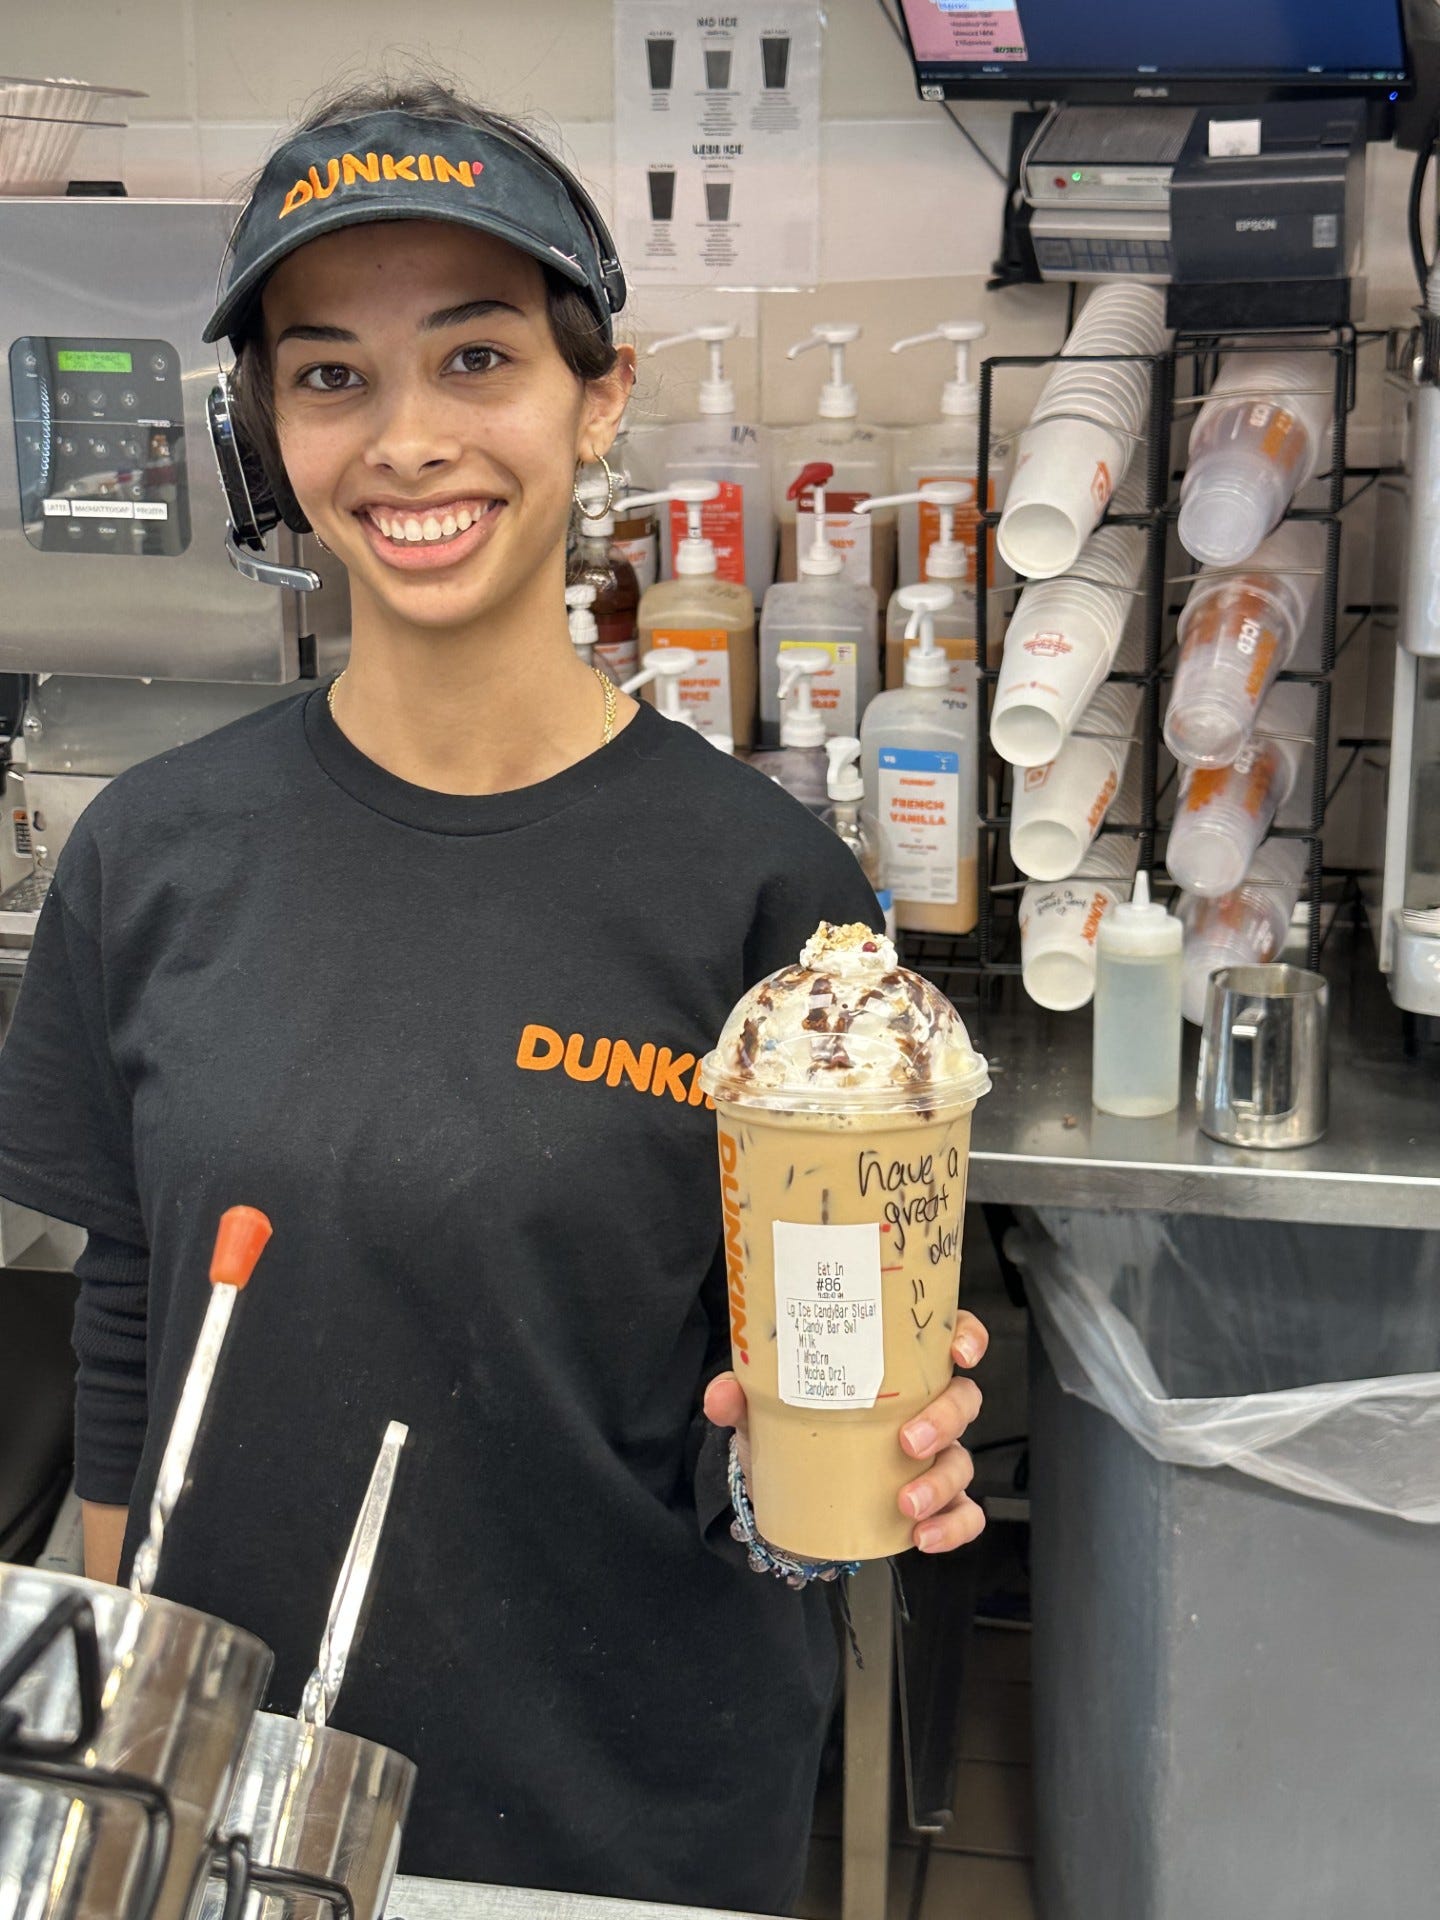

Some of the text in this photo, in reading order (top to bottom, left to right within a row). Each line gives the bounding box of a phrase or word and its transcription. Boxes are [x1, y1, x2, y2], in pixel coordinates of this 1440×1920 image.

[279, 152, 484, 219] DUNKIN'
[1235, 218, 1277, 231] EPSON
[1237, 618, 1260, 656] ICED
[891, 797, 945, 811] FRENCH
[889, 812, 947, 826] VANILLA
[516, 1023, 717, 1110] DUNKI
[858, 1147, 959, 1197] have a
[884, 1184, 950, 1251] great
[719, 1130, 749, 1366] DUNKIN'
[929, 1222, 961, 1266] day
[817, 1261, 844, 1276] Eat In
[816, 1277, 841, 1292] #86
[786, 1301, 796, 1318] Lg
[798, 1301, 811, 1317] Ice
[813, 1303, 849, 1320] CandyBar
[794, 1317, 799, 1332] 4
[802, 1318, 823, 1335] Candy
[827, 1319, 840, 1334] Bar
[798, 1333, 816, 1348] Milk
[796, 1348, 800, 1364] 1
[796, 1364, 846, 1381] 1 Mocha Drzl
[797, 1380, 856, 1398] 1 Candybar Top
